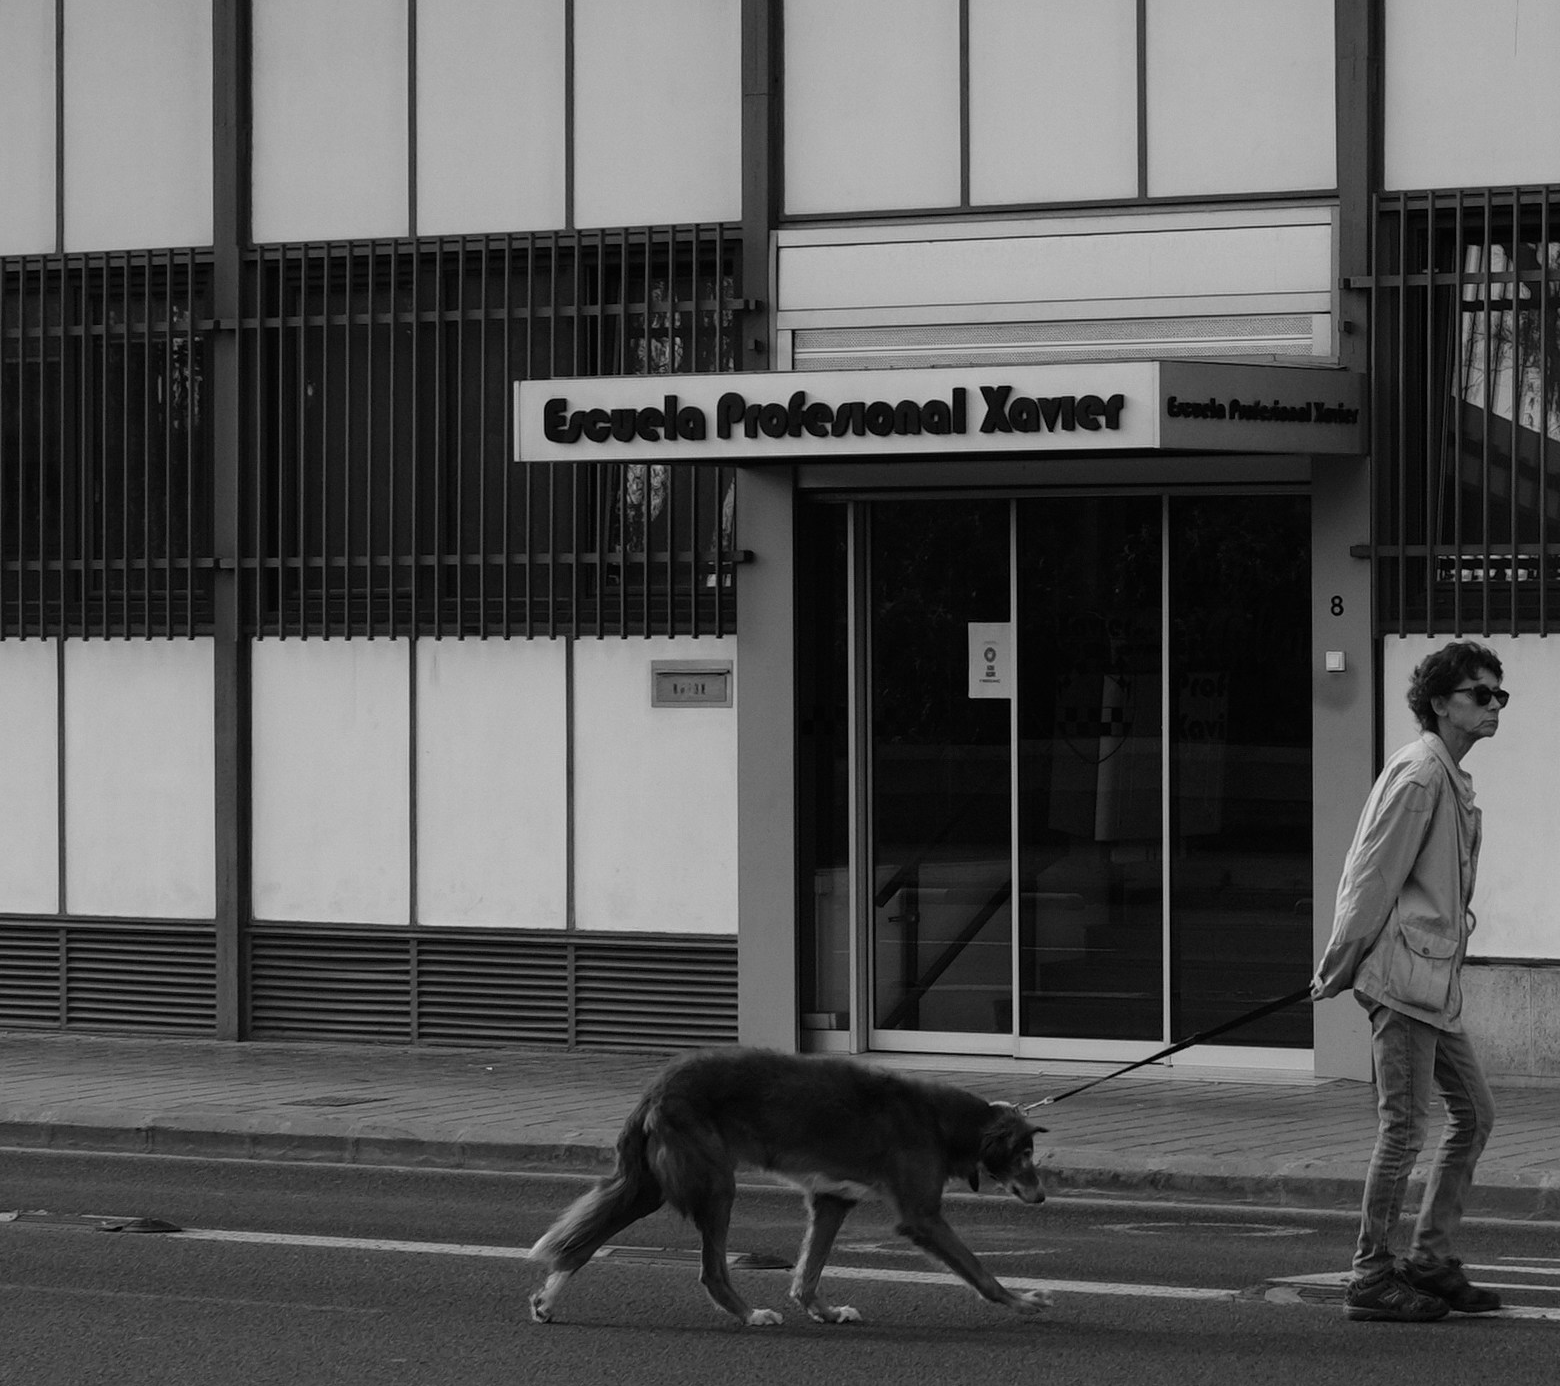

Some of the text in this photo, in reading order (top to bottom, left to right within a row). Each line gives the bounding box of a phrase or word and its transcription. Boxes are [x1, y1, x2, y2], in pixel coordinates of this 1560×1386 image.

[543, 385, 1126, 445] Escuela Profesional Xavier
[1330, 595, 1345, 617] 8
